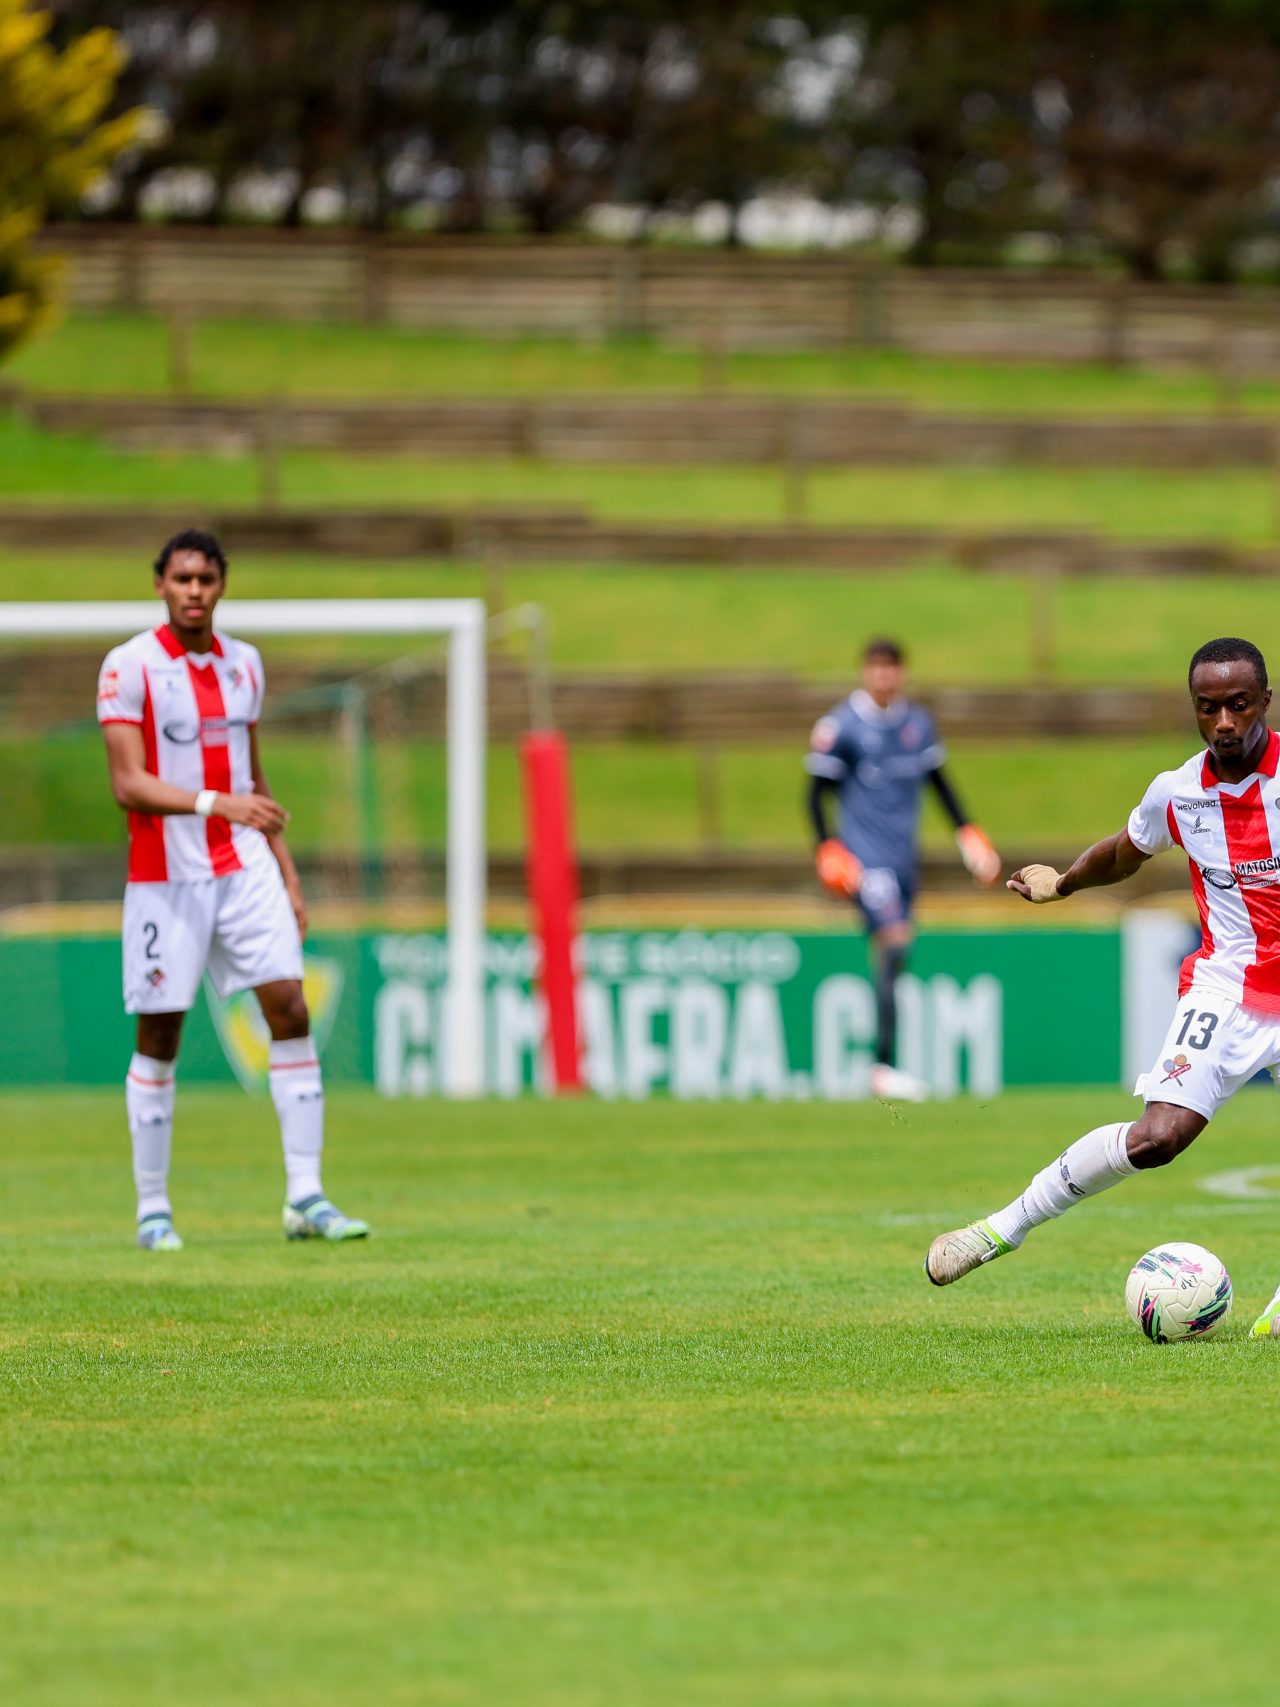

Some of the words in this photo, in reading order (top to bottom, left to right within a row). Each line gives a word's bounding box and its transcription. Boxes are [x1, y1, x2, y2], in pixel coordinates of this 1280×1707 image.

[143, 922, 160, 959] 2
[372, 974, 1003, 1099] CMAFRA.COM
[1176, 1008, 1219, 1050] 13
